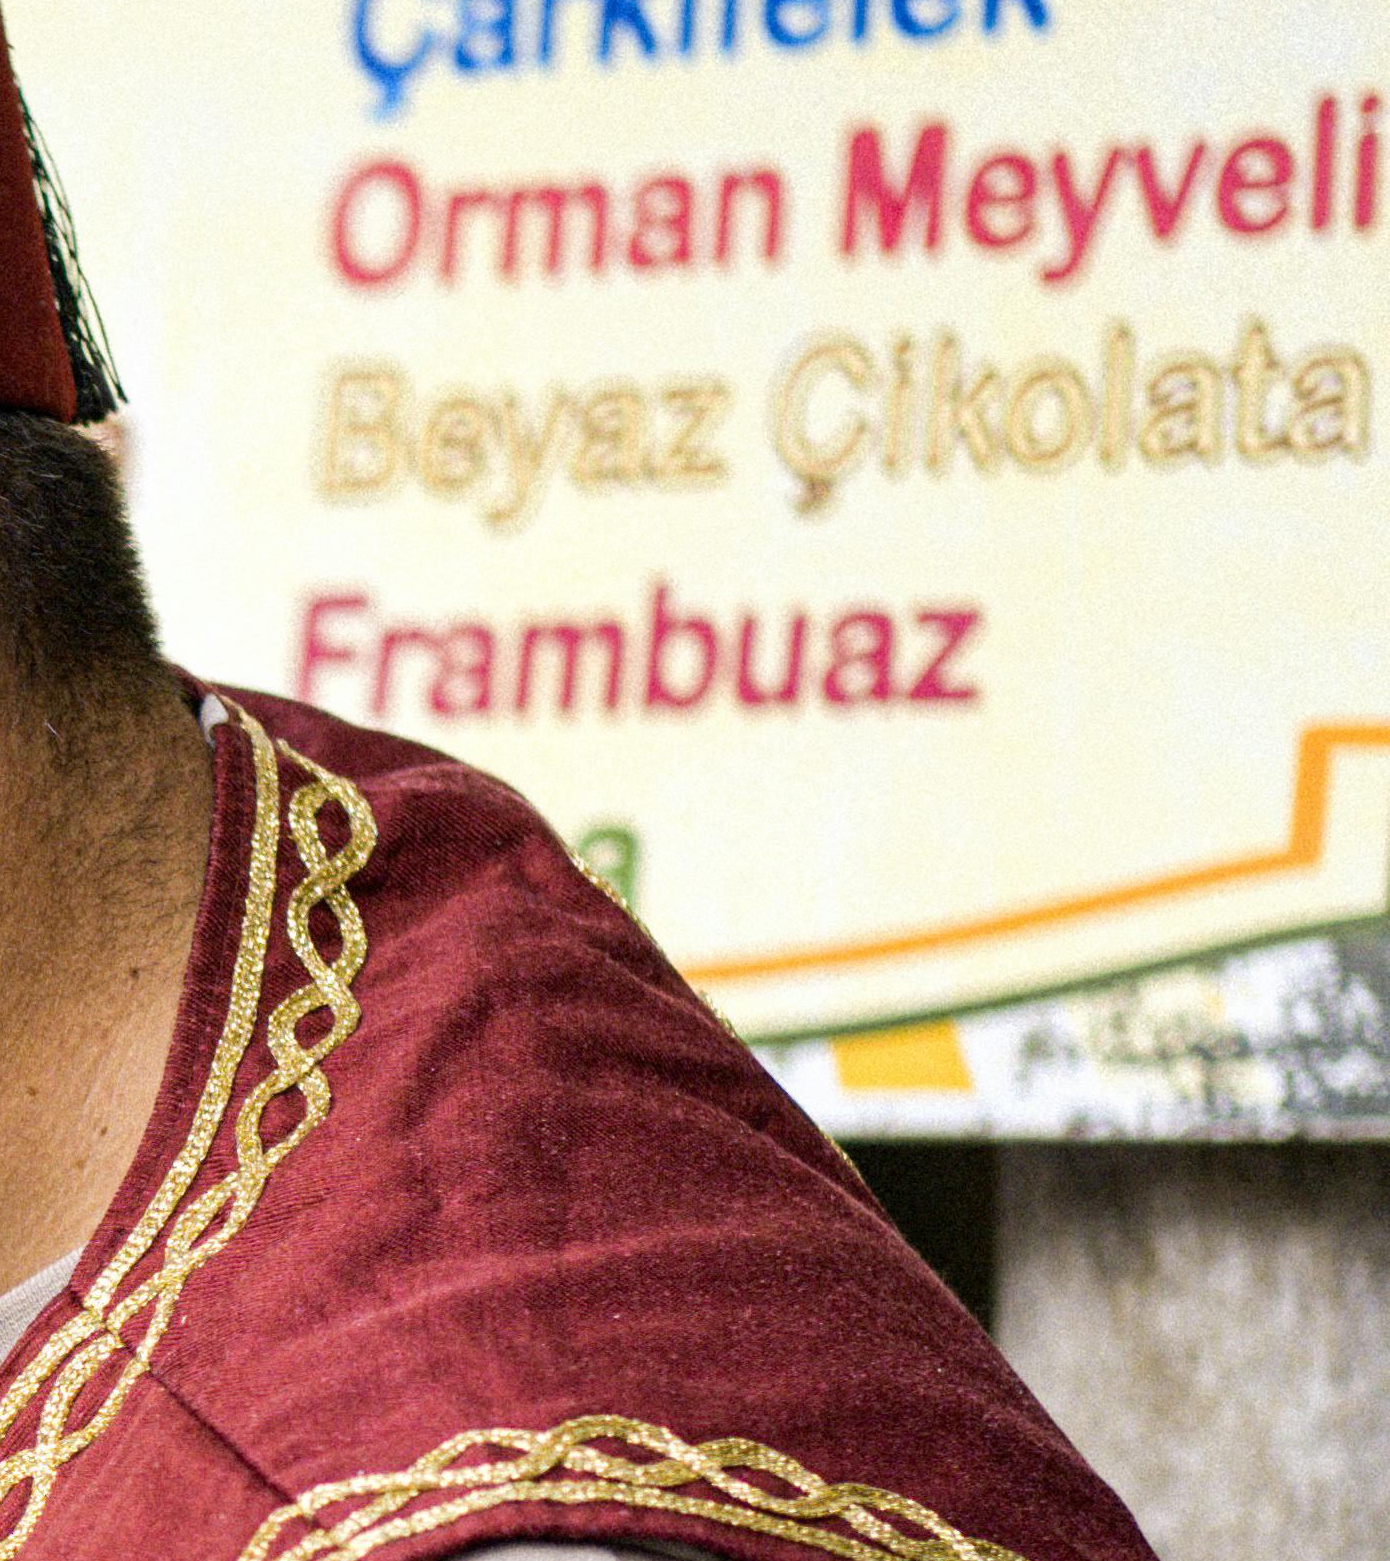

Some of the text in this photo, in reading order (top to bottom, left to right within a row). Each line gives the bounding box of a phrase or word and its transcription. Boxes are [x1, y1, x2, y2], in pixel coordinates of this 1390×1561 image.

[327, 90, 1384, 291] Orman Meyveli
[316, 315, 1373, 533] Beyaz Çikolata
[293, 585, 980, 722] Frambuaz
